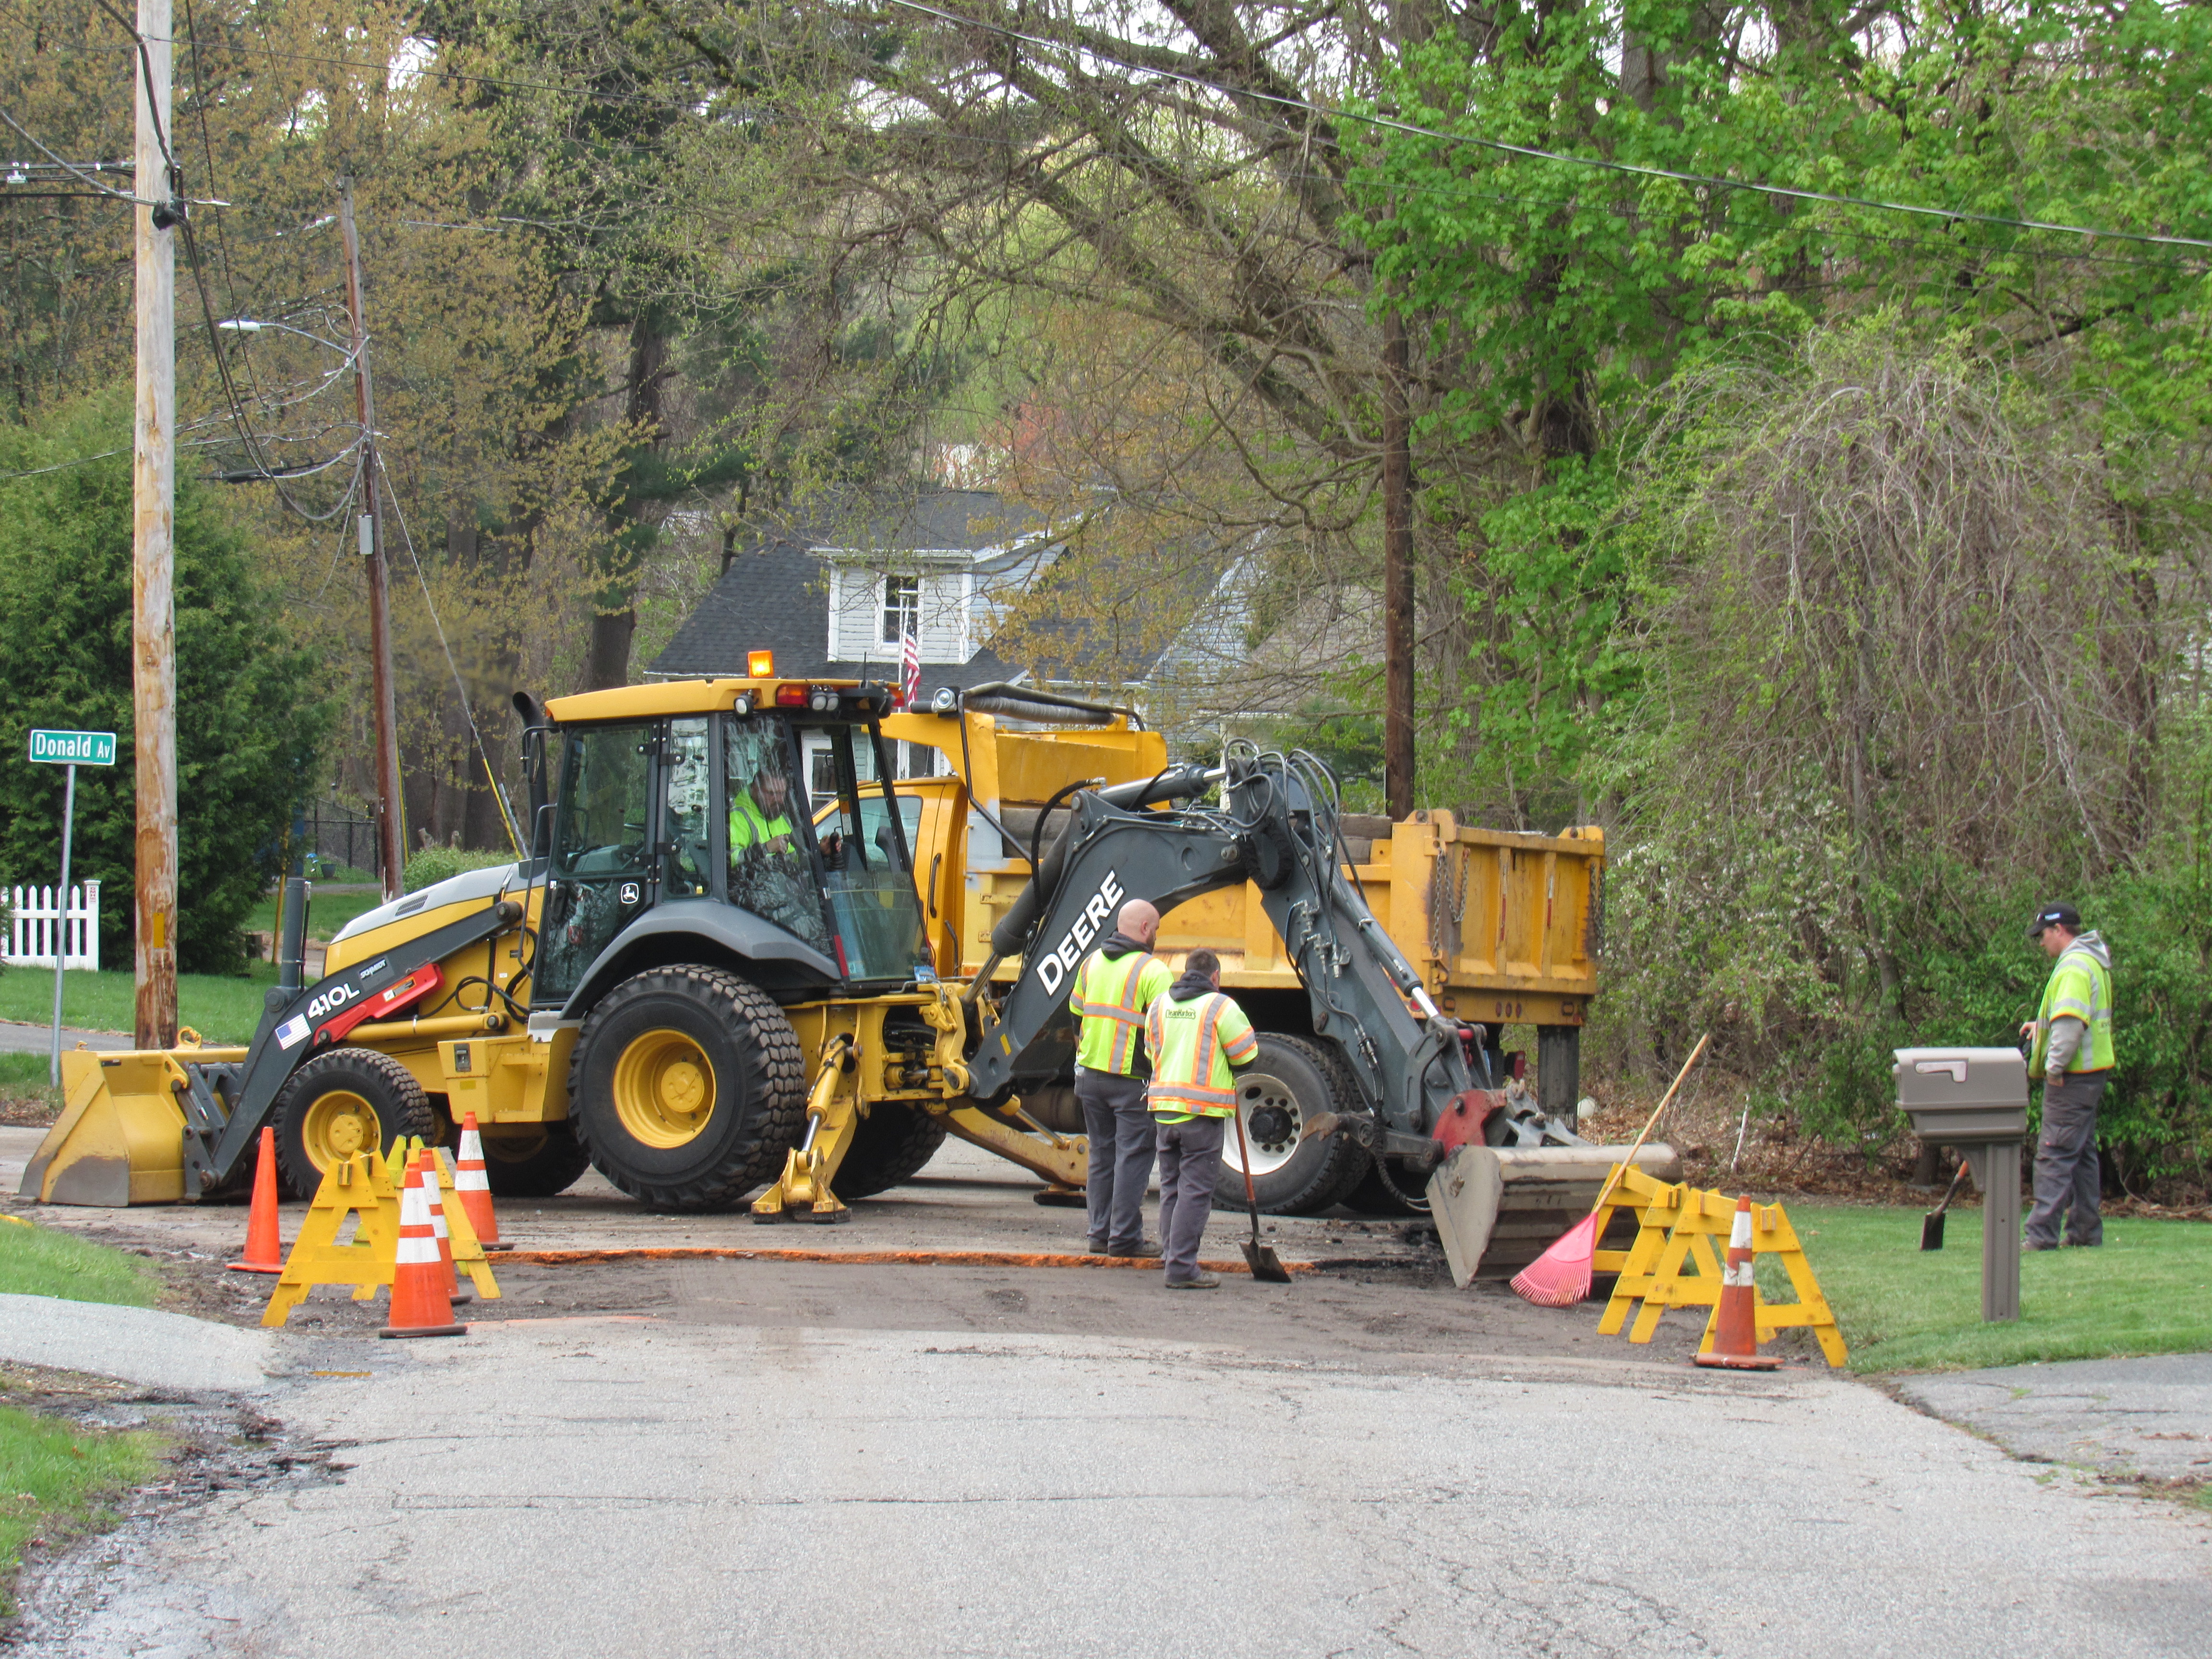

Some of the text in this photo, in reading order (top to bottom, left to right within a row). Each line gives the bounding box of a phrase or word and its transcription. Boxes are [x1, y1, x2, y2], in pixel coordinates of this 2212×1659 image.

[36, 733, 110, 758] Donald Av
[1036, 869, 1124, 996] DEERE
[360, 959, 385, 978] SCHMIDT
[308, 983, 360, 1018] 410L
